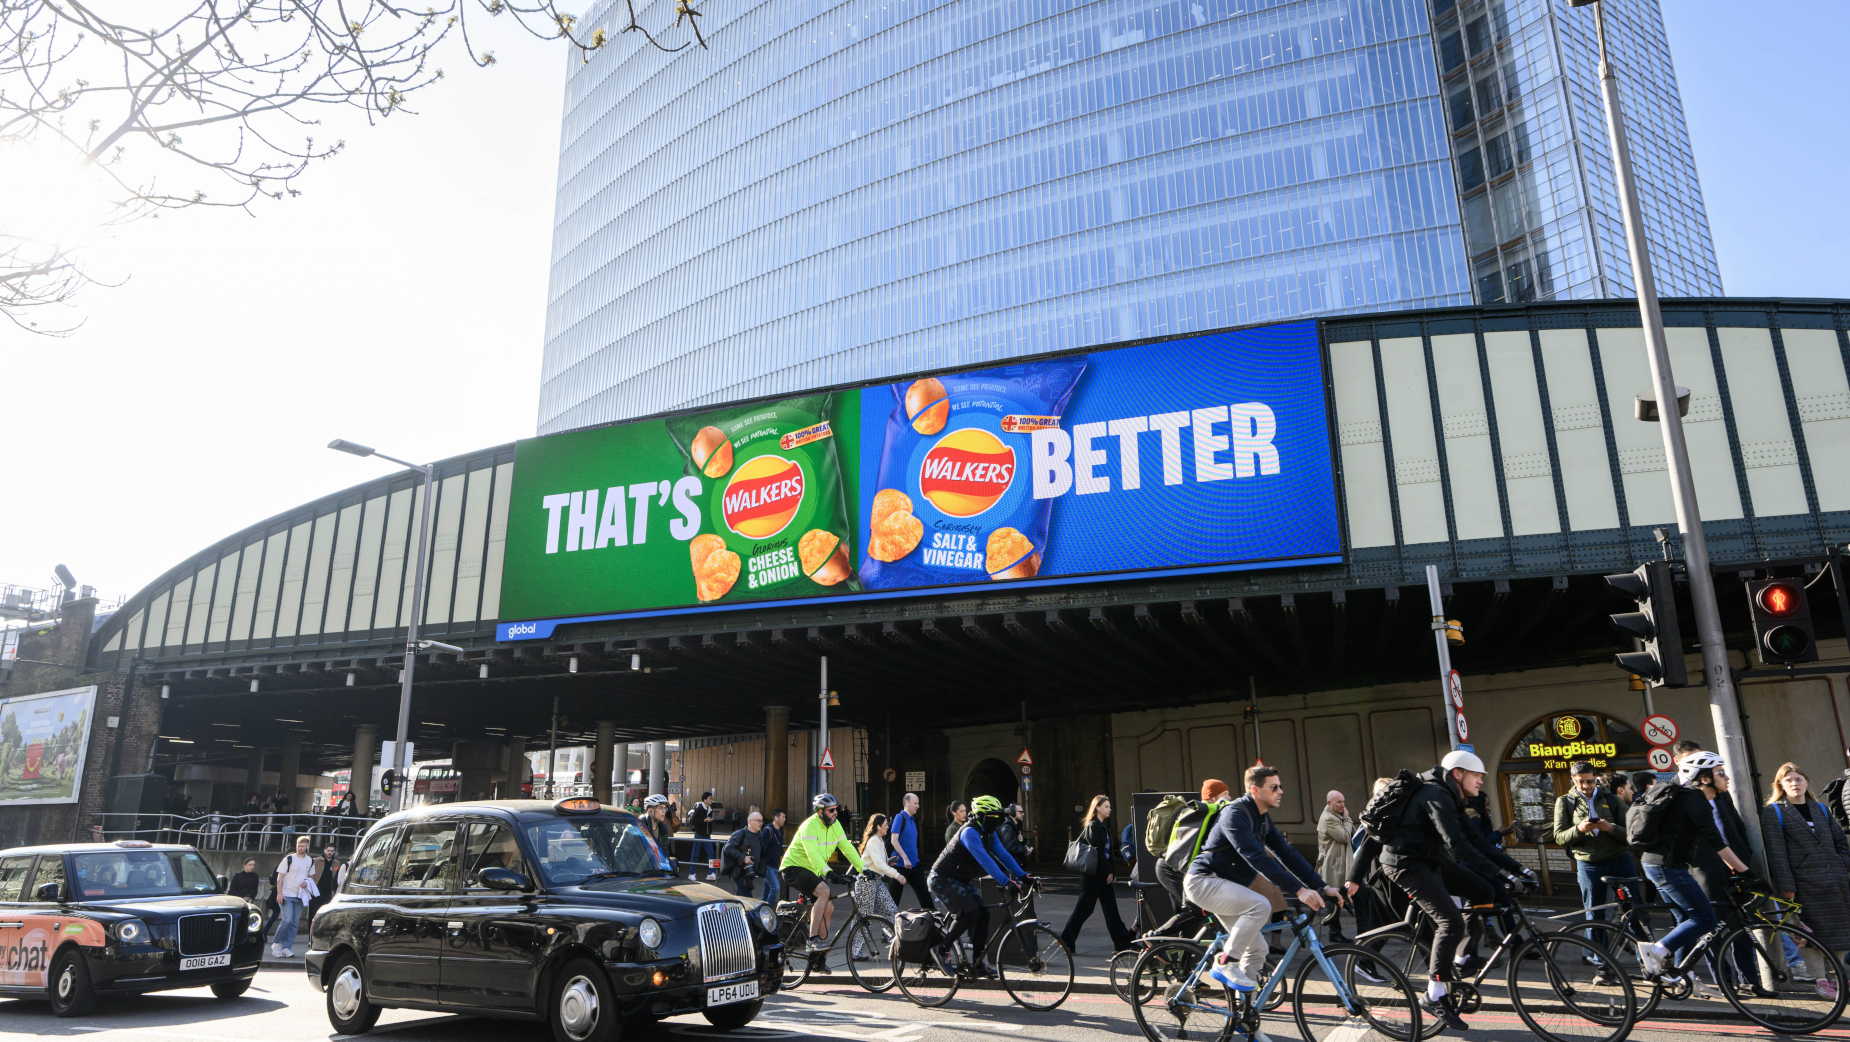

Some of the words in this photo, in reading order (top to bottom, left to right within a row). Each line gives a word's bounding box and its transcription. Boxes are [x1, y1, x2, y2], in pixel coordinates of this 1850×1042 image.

[953, 384, 969, 393] SOME
[970, 383, 980, 391] SEE
[951, 403, 960, 411] WE
[730, 421, 744, 433] SOME
[743, 417, 753, 426] SEE
[1019, 417, 1038, 425] 100%
[1039, 418, 1060, 426] GREAT
[794, 429, 812, 440] 100%
[811, 422, 829, 434] GREAT
[733, 440, 742, 449] WE
[740, 435, 750, 444] SEE
[1031, 402, 1281, 500] BETTER
[924, 457, 1013, 484] WALKERS
[725, 476, 802, 515] WALKERS
[542, 475, 703, 554] THAT'S
[932, 532, 966, 550] SALT
[966, 535, 977, 552] &
[748, 546, 794, 572] CHEESE
[923, 548, 984, 569] VINEGAR
[748, 573, 759, 588] &
[759, 561, 799, 586] ONION
[508, 623, 536, 639] global
[1529, 741, 1616, 759] BiangBiang
[1652, 753, 1668, 765] 10
[1544, 760, 1567, 769] Xi'an
[1570, 758, 1607, 768] ndles
[571, 800, 597, 809] TAXI
[7, 937, 48, 972] chat
[207, 955, 226, 966] GAZ
[712, 986, 737, 1003] LP64
[740, 982, 756, 998] UDU
